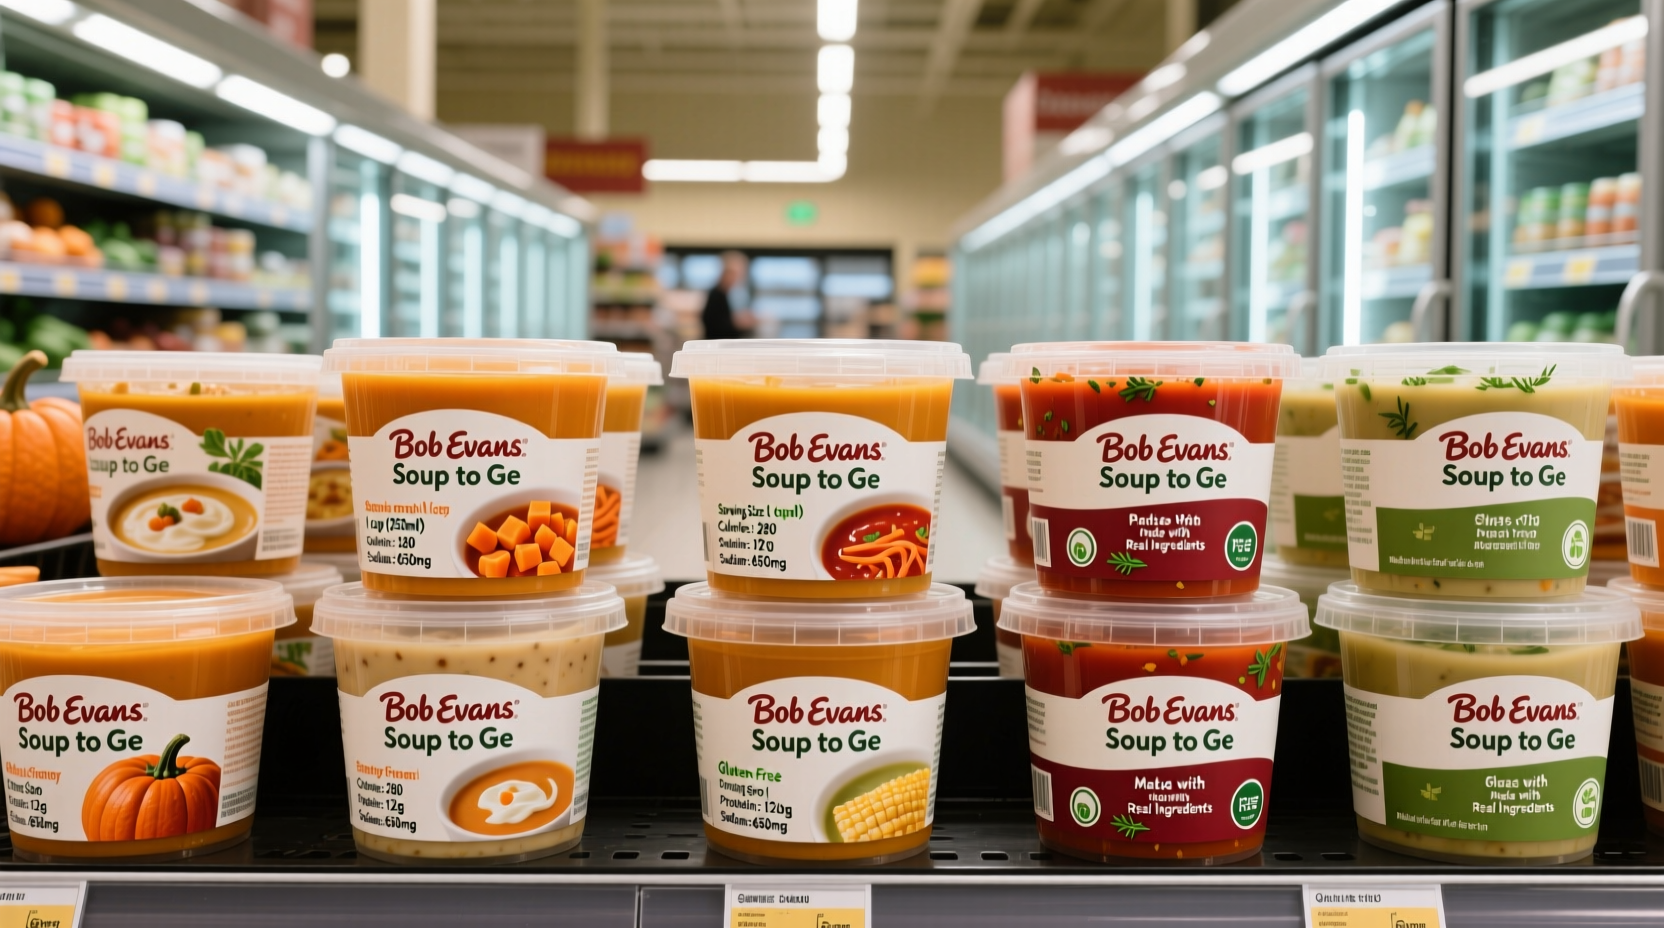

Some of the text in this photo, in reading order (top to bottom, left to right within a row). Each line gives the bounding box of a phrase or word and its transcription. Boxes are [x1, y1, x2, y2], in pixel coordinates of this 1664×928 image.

[88, 427, 170, 450] Bob Evans
[389, 429, 522, 459] Bob Evans
[748, 432, 882, 462] Bob Evans
[1096, 432, 1228, 463] Bob Evans
[1439, 431, 1568, 461] Bob Evans
[122, 457, 139, 473] to
[143, 456, 169, 473] Ge
[393, 463, 521, 491] Soup to Ge
[1442, 464, 1566, 491] Soup to Ge
[752, 466, 880, 495] Soup to Ge
[1099, 466, 1227, 494] Soup to Ge
[14, 692, 143, 725] Bob Evans
[379, 692, 514, 723] Bob Evans
[748, 694, 882, 725] Bob Evans
[1102, 693, 1235, 724] Bob Evans
[1448, 693, 1577, 724] Bob Evans
[19, 727, 143, 757] Soup to Ge
[384, 726, 513, 756] Soup to Ge
[752, 729, 881, 759] Soup to Ge
[1106, 728, 1234, 756] Soup to Ge
[1450, 727, 1576, 756] Soup to Ge
[719, 761, 782, 782] Gluten Free
[1177, 776, 1205, 789] with
[386, 799, 404, 815] 12g
